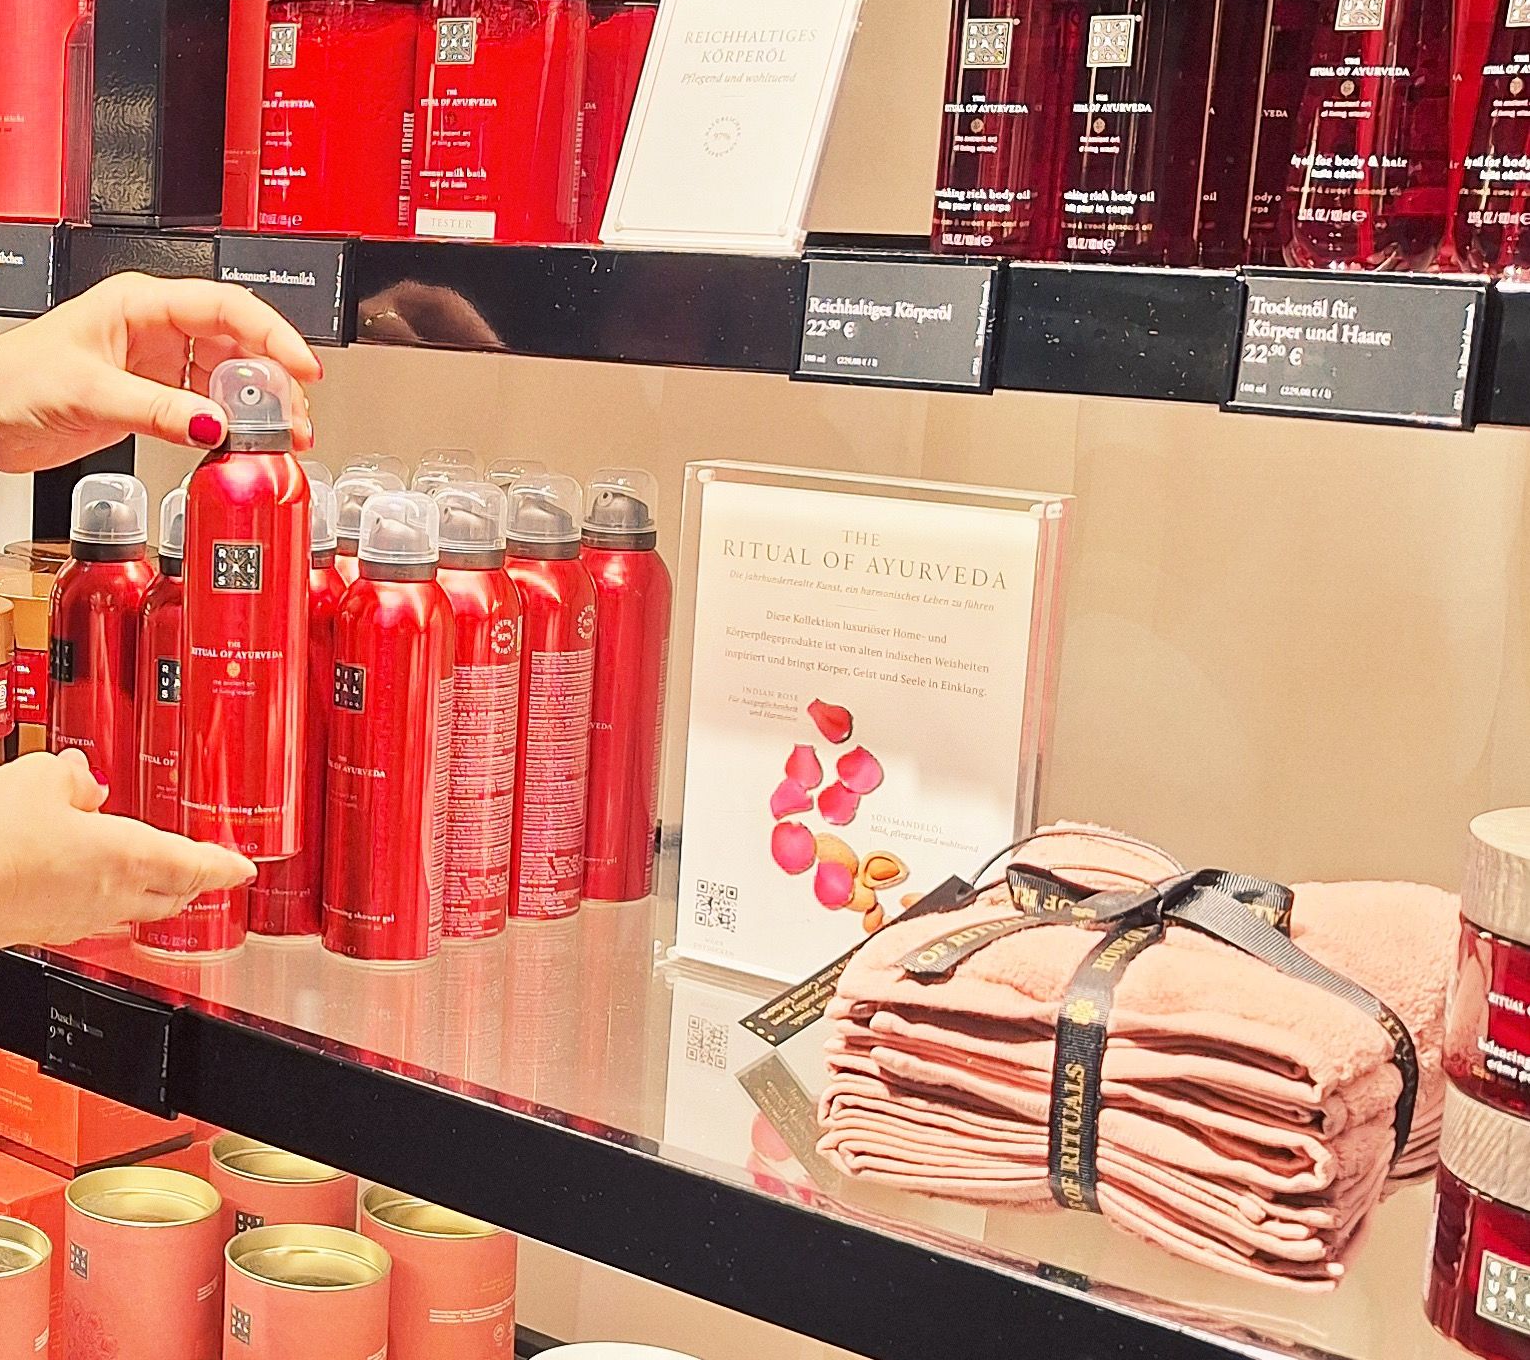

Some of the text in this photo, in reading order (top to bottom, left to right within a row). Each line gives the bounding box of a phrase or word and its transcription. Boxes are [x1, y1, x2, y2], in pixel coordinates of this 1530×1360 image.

[684, 28, 818, 45] REICHHALTIGES
[701, 49, 787, 64] KÖRPERÖL
[680, 72, 797, 86] Pflegend und wohltuend
[1351, 66, 1411, 78] AYURVEDA
[978, 104, 1029, 114] AYURVEDA
[1100, 103, 1153, 114] AYURVEDA
[1334, 154, 1408, 169] body hair
[988, 189, 1032, 203] body oil
[1110, 191, 1156, 205] body oil
[430, 216, 474, 230] TESTER
[221, 267, 316, 287] Kokosnuss-Bademilch
[807, 297, 953, 324] Reichhaltiges Körperöl
[1249, 294, 1358, 321] Trockenöl für
[843, 320, 856, 339] €
[1246, 318, 1393, 347] Körper und Haare
[1288, 346, 1304, 367] €
[841, 529, 881, 547] THE
[723, 538, 1007, 590] RITUAL OF AYURVEDA
[729, 568, 744, 580] Die
[816, 580, 844, 594] Kunst,
[845, 585, 859, 595] ein
[860, 586, 921, 603] harmonisches
[923, 593, 950, 607] Leben
[951, 599, 963, 608] zu
[963, 599, 996, 613] führen
[766, 610, 948, 645] Diese Kollektion luxuriöser Home- und
[191, 646, 284, 660] RITUAL OF AYURVEDA
[725, 625, 990, 674] Körperpflegeprodukte ist von alten indischen Weisheiten
[724, 648, 988, 697] inspiriert und bringt Körper, Geist und Seele in Einklang.
[776, 691, 799, 703] ROSE
[342, 765, 386, 778] AYURVEDA
[218, 803, 253, 816] foaming
[254, 805, 281, 814] shower
[354, 913, 395, 924] shower gel
[1061, 1062, 1085, 1171] RITUALS
[1062, 1171, 1083, 1202] OF
